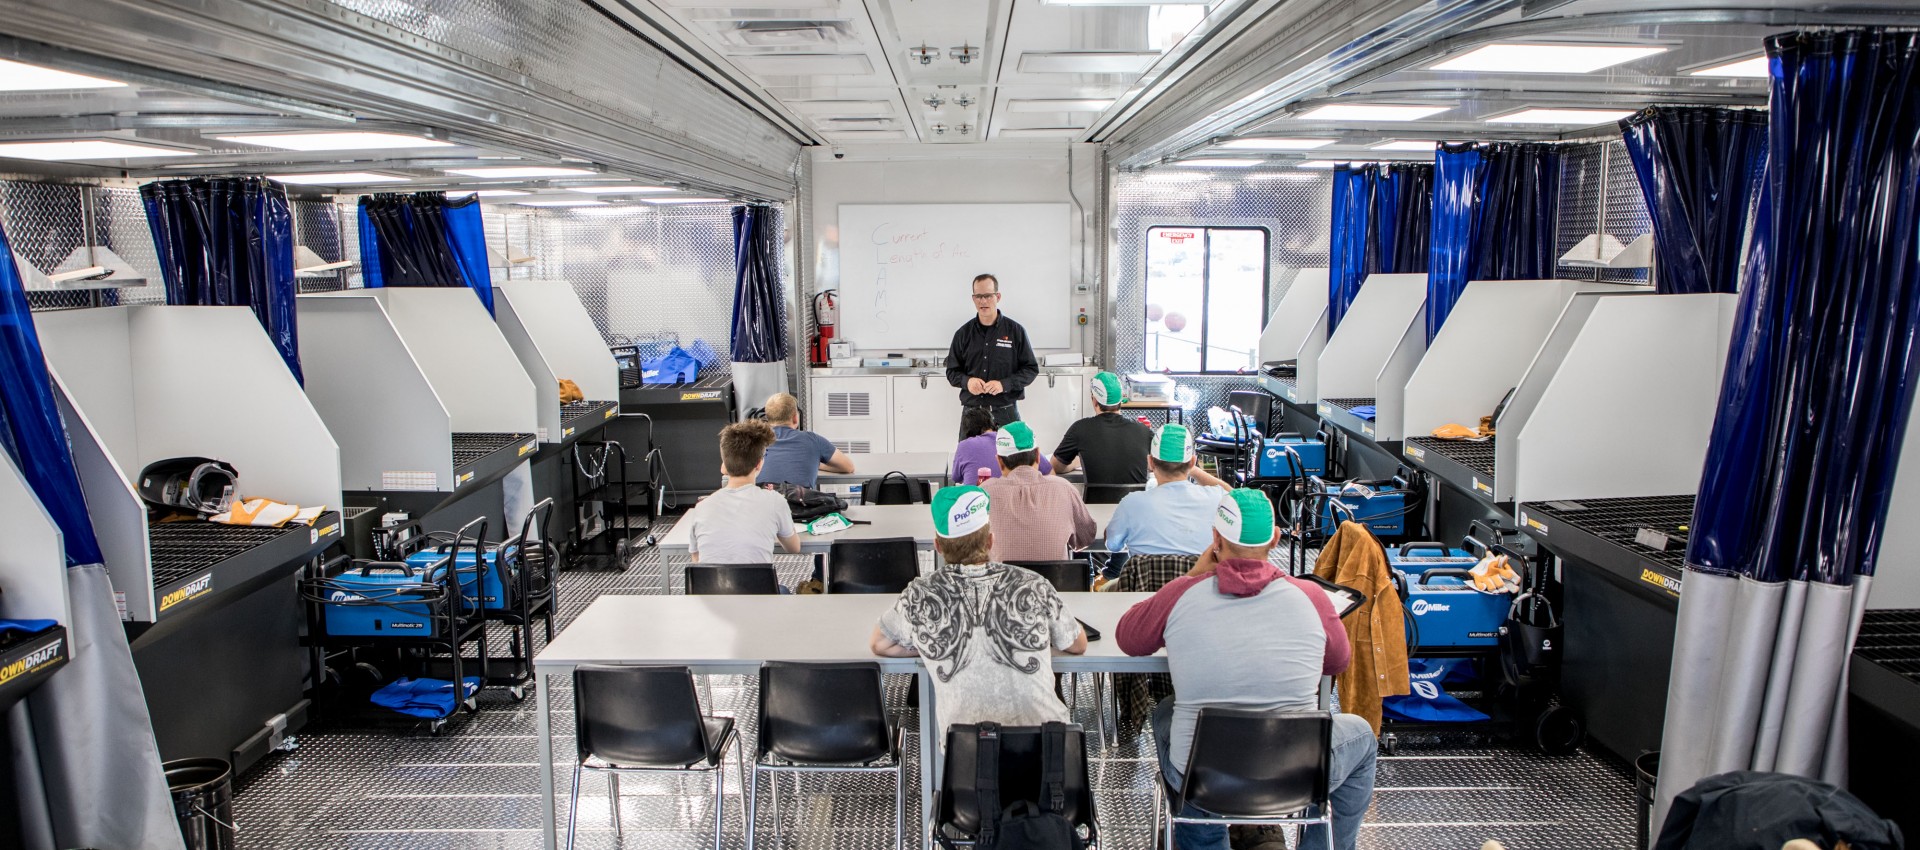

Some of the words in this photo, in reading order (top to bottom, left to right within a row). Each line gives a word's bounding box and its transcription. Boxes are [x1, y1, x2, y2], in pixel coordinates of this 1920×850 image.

[162, 577, 210, 605] DOWNDRAFT
[1642, 568, 1681, 592] DOWNDRA
[1427, 603, 1450, 611] Miller
[0, 642, 59, 679] OWNDRAFT
[1411, 665, 1445, 680] Miller
